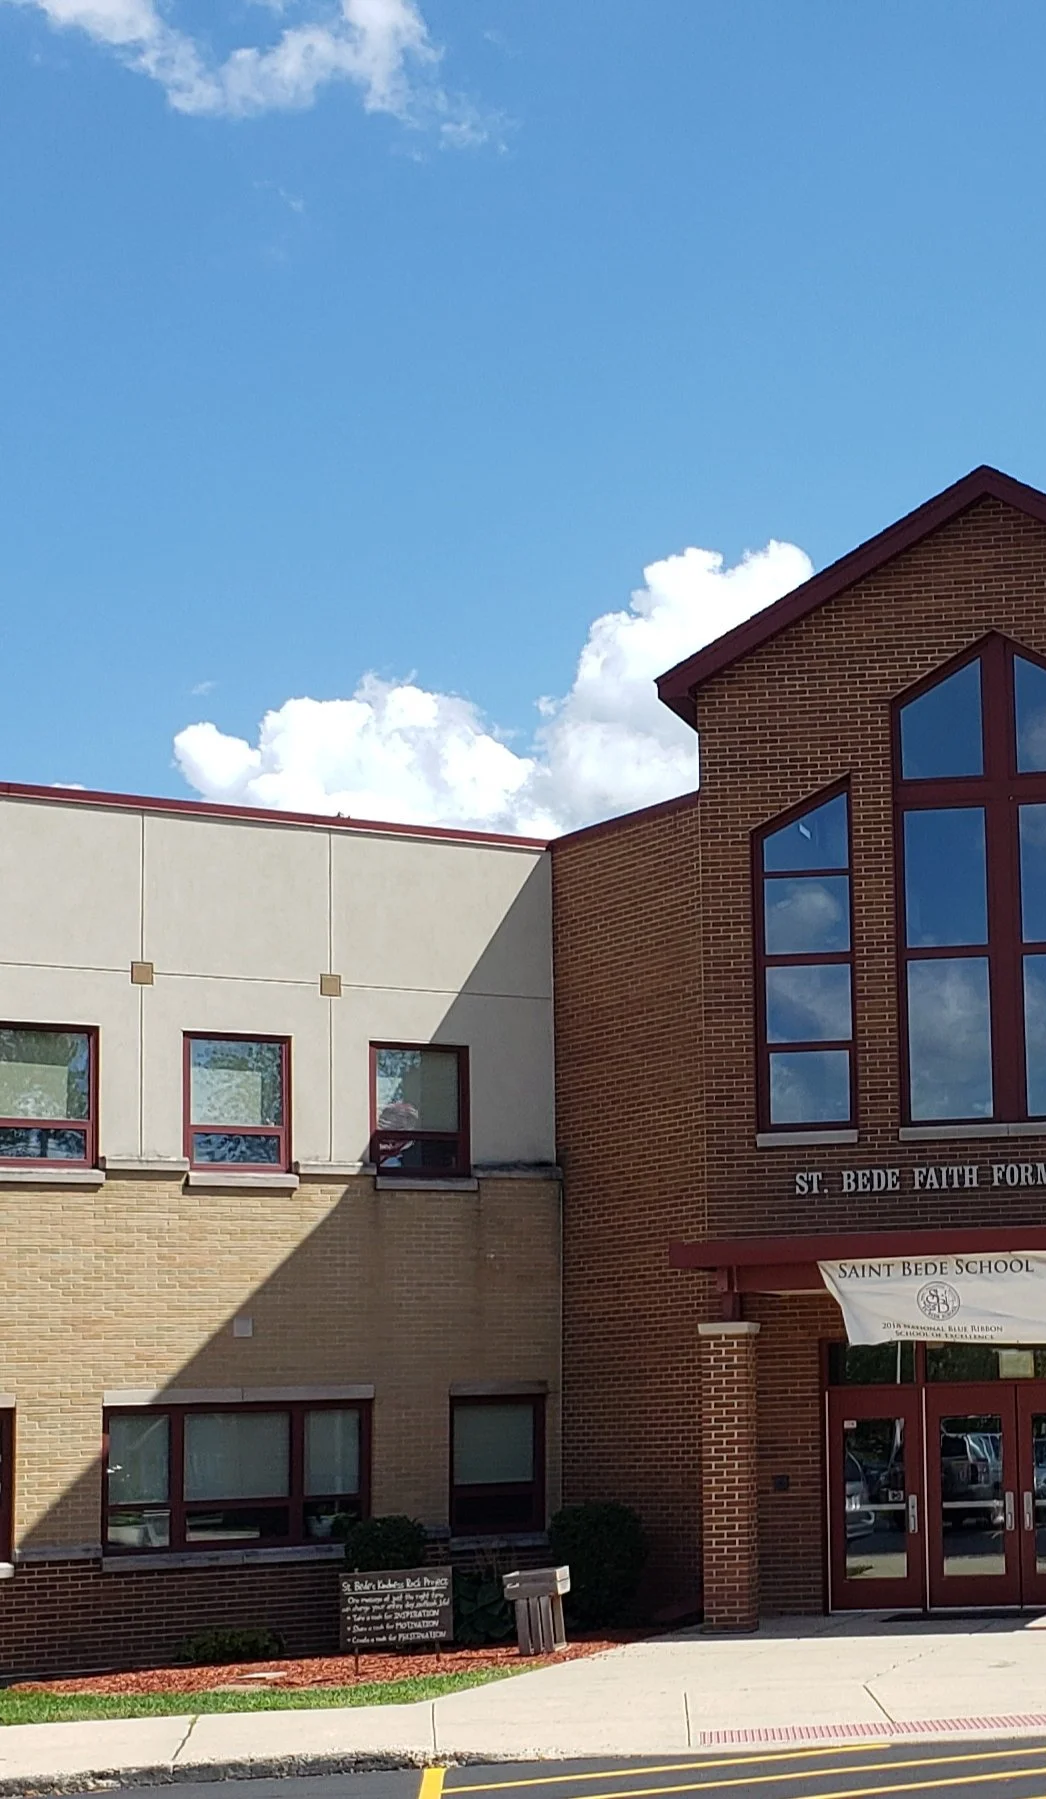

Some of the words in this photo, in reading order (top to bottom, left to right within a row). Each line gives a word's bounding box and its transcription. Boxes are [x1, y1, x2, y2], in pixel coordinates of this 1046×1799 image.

[795, 1171, 829, 1195] ST.
[841, 1168, 900, 1193] BEDE
[913, 1165, 979, 1190] FAITH
[838, 1263, 895, 1278] SAINT
[902, 1261, 949, 1277] BEDE
[955, 1258, 1035, 1275] SCHOOL
[895, 1330, 928, 1338] SCHOOL
